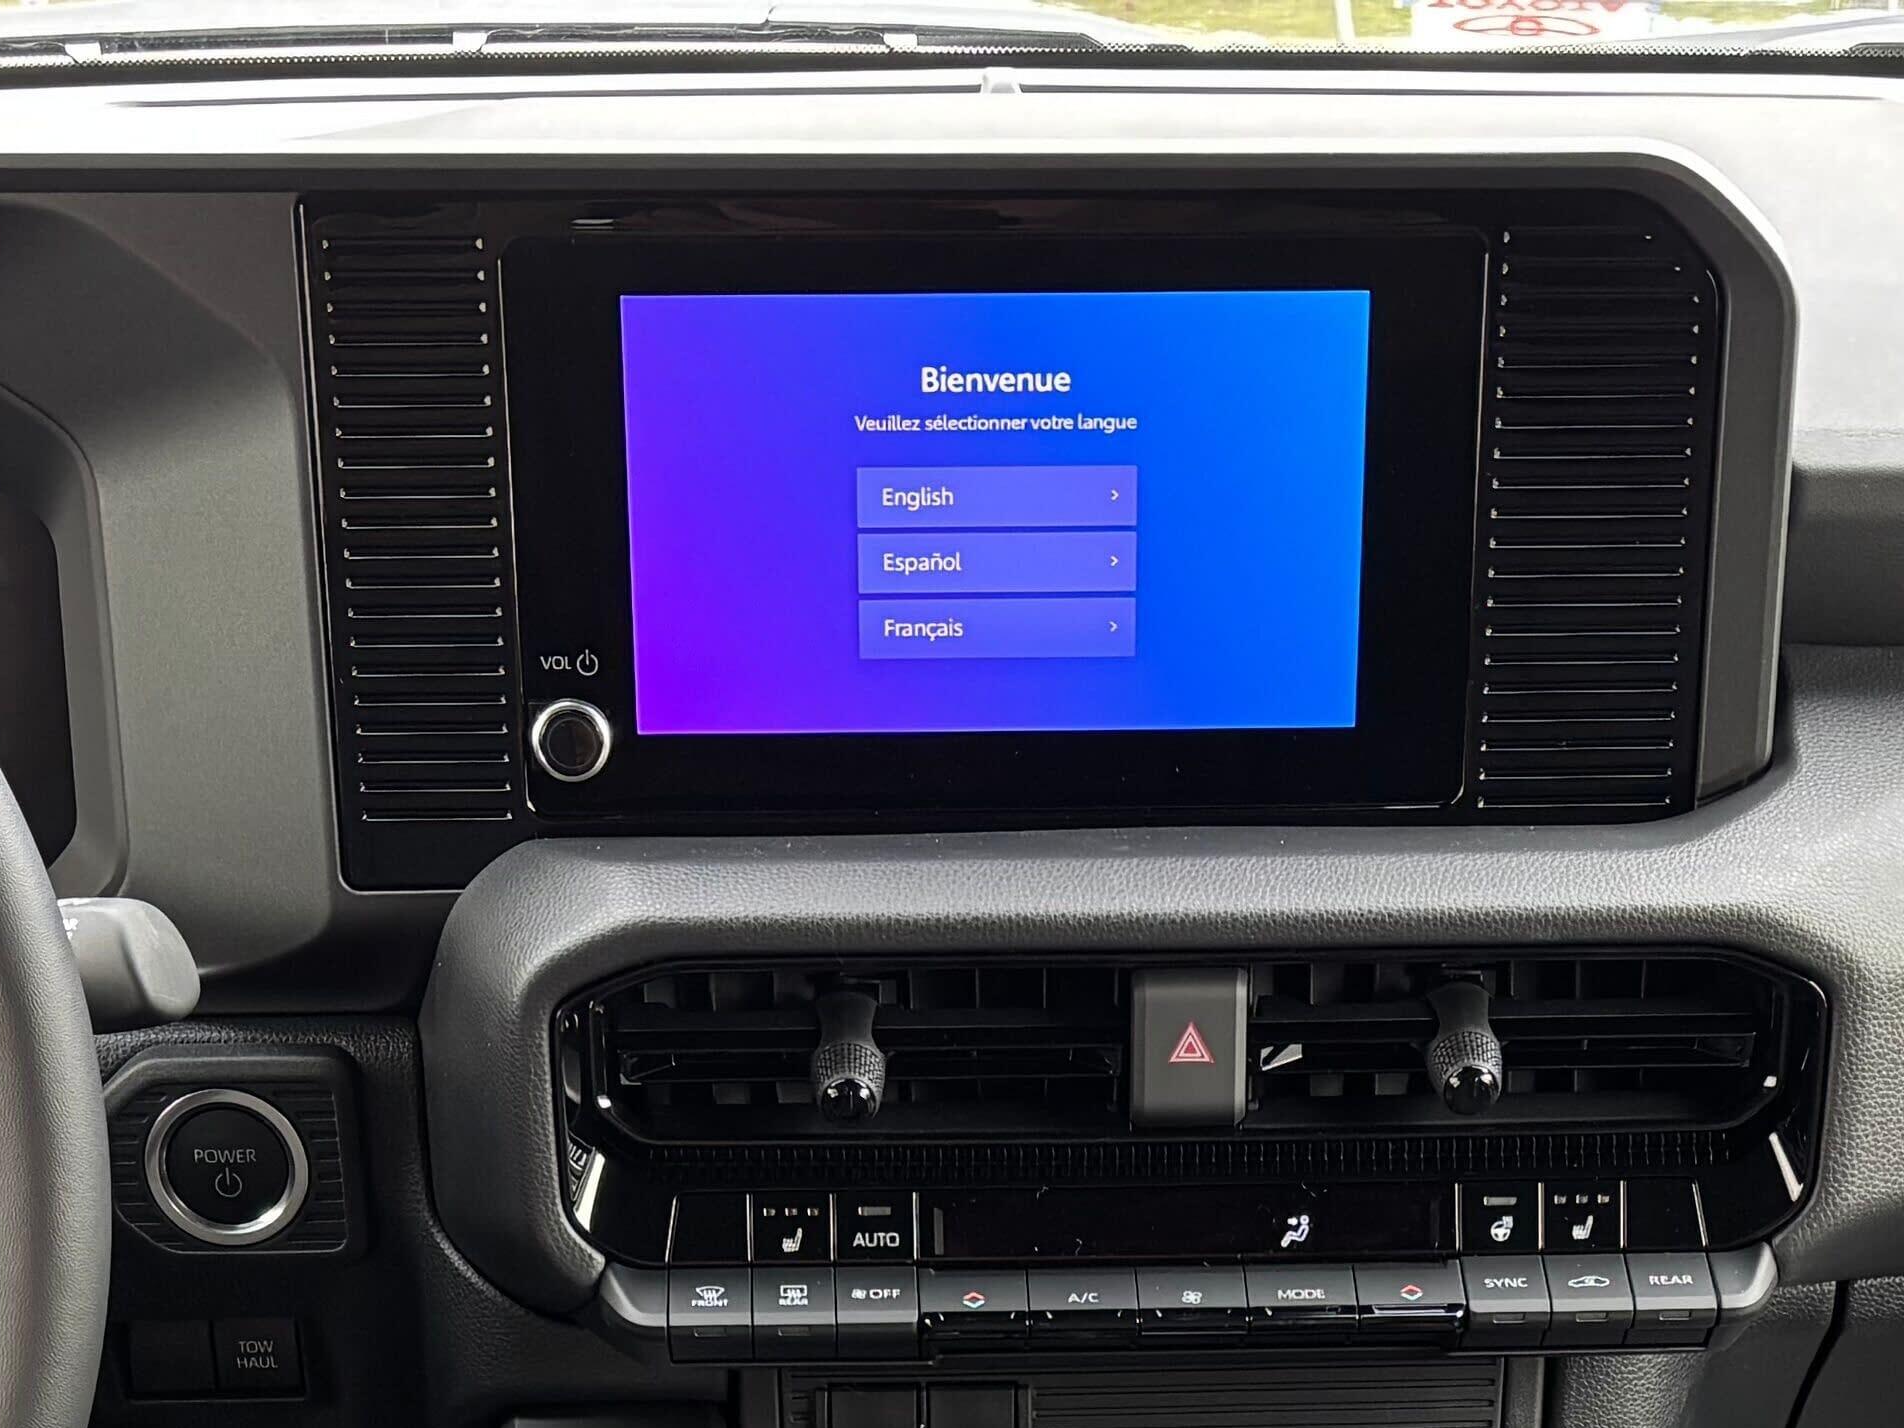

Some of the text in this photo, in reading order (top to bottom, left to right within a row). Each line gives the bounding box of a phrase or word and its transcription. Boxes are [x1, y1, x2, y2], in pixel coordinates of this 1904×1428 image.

[921, 366, 1072, 393] Bienvenue
[854, 413, 1138, 434] Veuillez sélectionner votre langue
[881, 487, 954, 511] English
[882, 552, 962, 575] Español
[883, 617, 964, 642] Français
[540, 654, 572, 671] VOL
[194, 1149, 256, 1164] POWER
[853, 1231, 900, 1249] AUTO
[1483, 1275, 1530, 1290] SYNC
[1648, 1273, 1694, 1288] REAR
[869, 1288, 901, 1300] OFF
[1067, 1291, 1101, 1306] A/C
[1277, 1288, 1325, 1302] MODE
[691, 1299, 729, 1308] FRONT
[778, 1298, 809, 1307] REAR
[238, 1339, 274, 1354] TOW
[237, 1356, 279, 1370] HAUL
